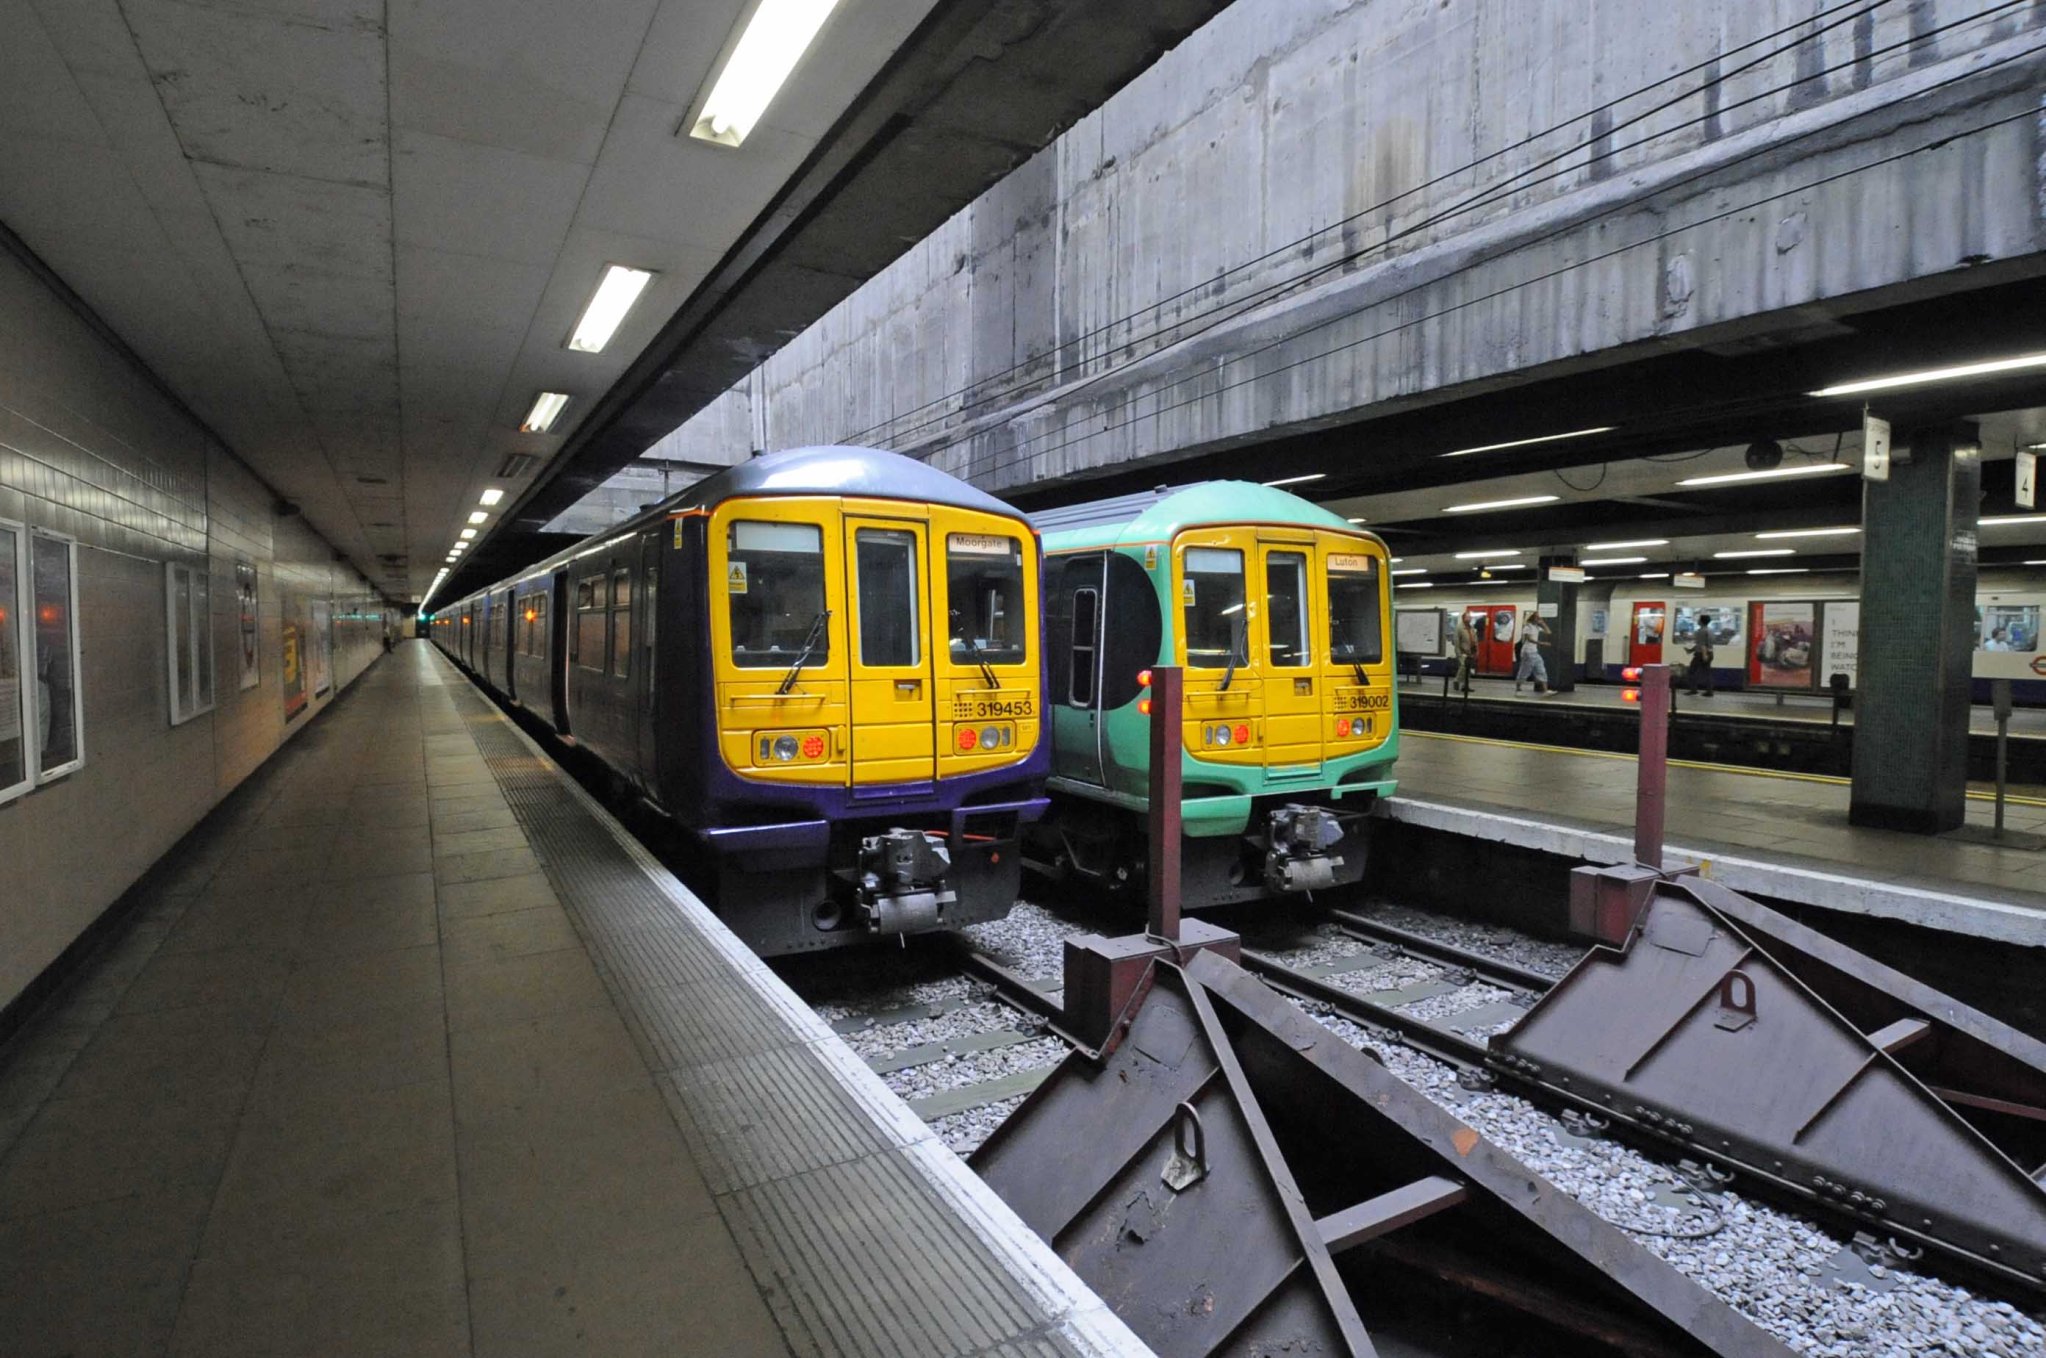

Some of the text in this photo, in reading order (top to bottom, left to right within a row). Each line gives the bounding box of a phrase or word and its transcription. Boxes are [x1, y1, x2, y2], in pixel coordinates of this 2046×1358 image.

[1873, 440, 1882, 470] 5
[2021, 475, 2029, 499] 4
[956, 536, 1003, 549] Moorgate
[1335, 556, 1358, 566] Luton
[977, 701, 1032, 717] 319453
[1350, 695, 1389, 709] 319002
